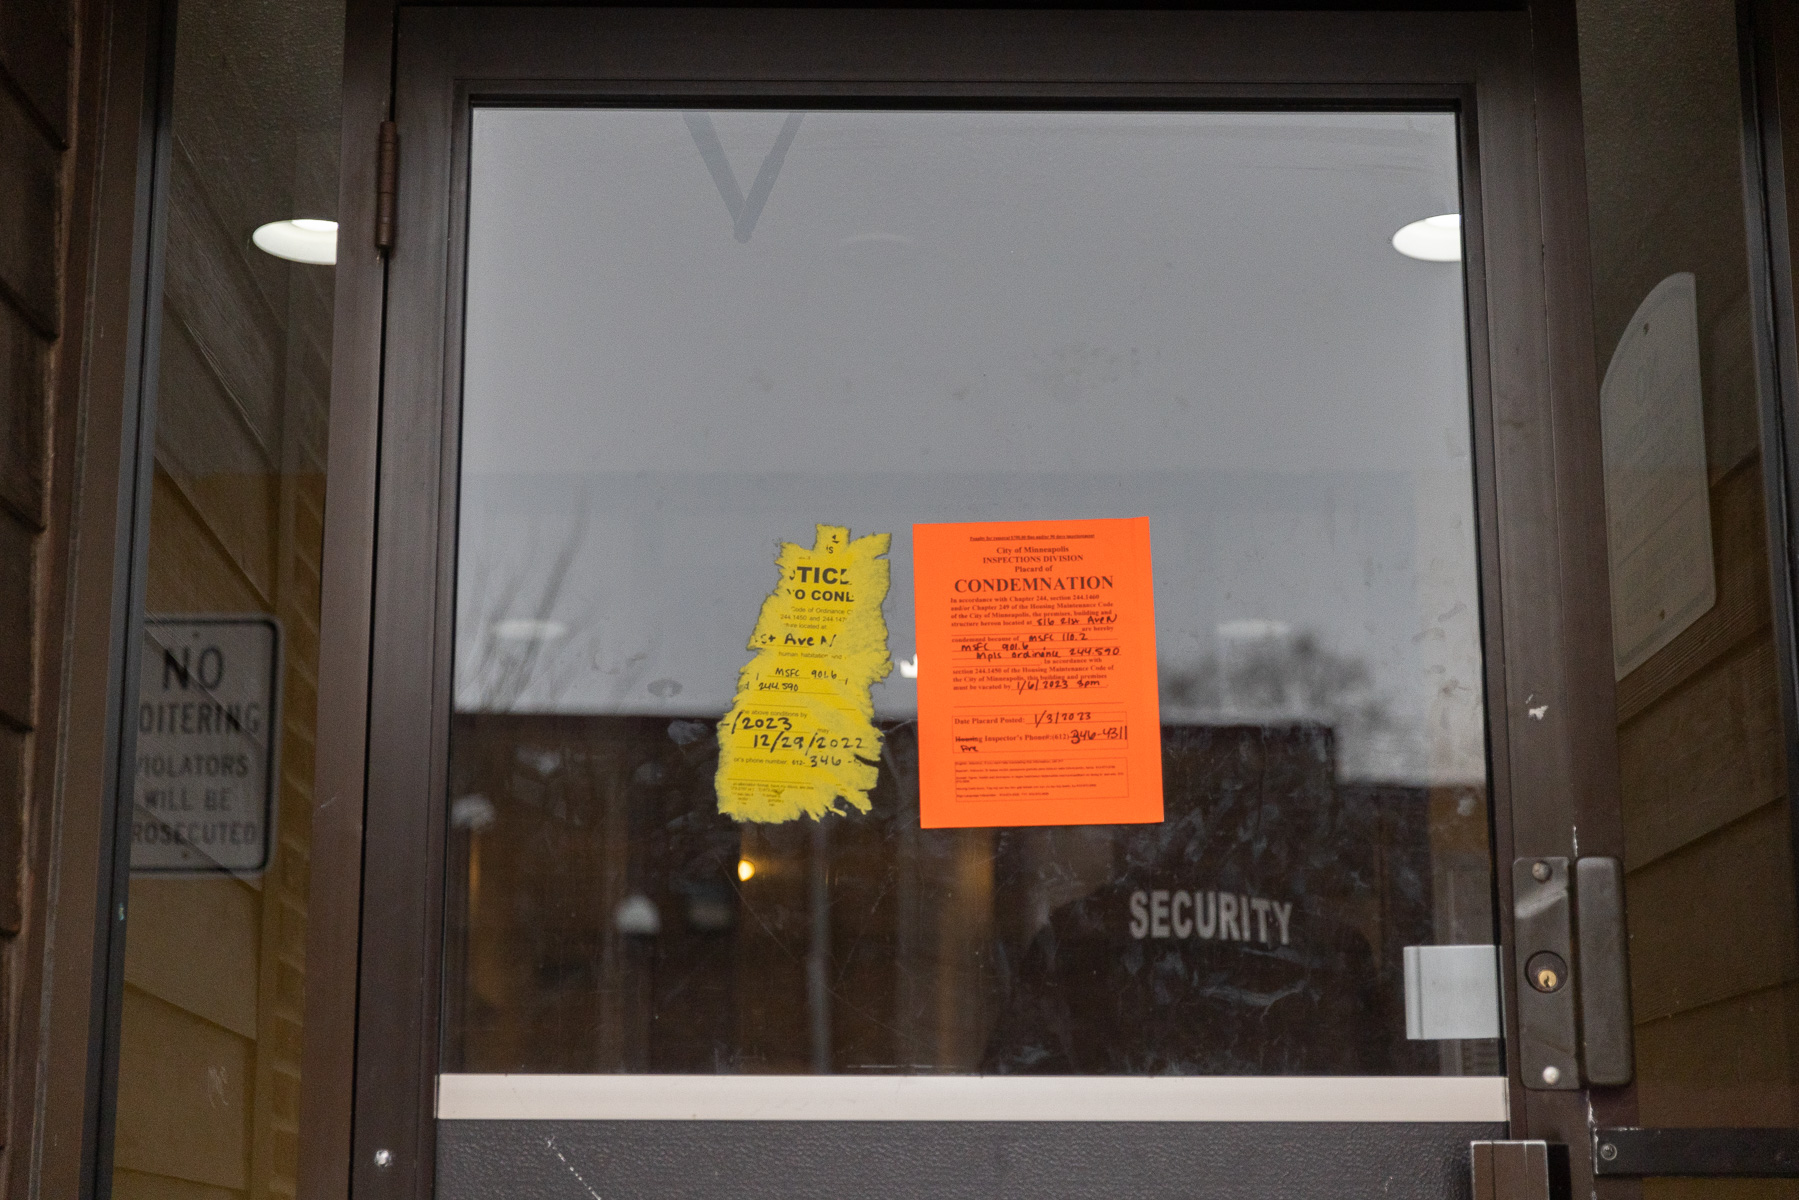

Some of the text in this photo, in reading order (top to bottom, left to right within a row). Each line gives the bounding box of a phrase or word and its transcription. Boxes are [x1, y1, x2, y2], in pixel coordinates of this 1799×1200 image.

[996, 545, 1070, 556] City of Minneapolis
[983, 554, 1084, 564] INSPECTIONS DIVISION
[1014, 564, 1054, 573] Placard of
[954, 575, 1114, 594] CONDEMNATION
[1009, 595, 1035, 603] Chapter
[816, 607, 845, 615] Ordinance
[1093, 625, 1114, 633] hereby
[784, 633, 815, 647] Ave
[162, 647, 225, 691] NO
[775, 667, 801, 678] MSFC
[1040, 673, 1066, 681] building
[1080, 673, 1108, 681] premises
[138, 701, 261, 735] OITERING
[770, 710, 799, 718] conditions
[1000, 716, 1026, 724] Posted:
[984, 735, 1023, 743] Inspector's
[144, 786, 232, 812] WILL BE
[132, 821, 256, 846] ROSECUTED
[1128, 889, 1293, 946] SECURITY
